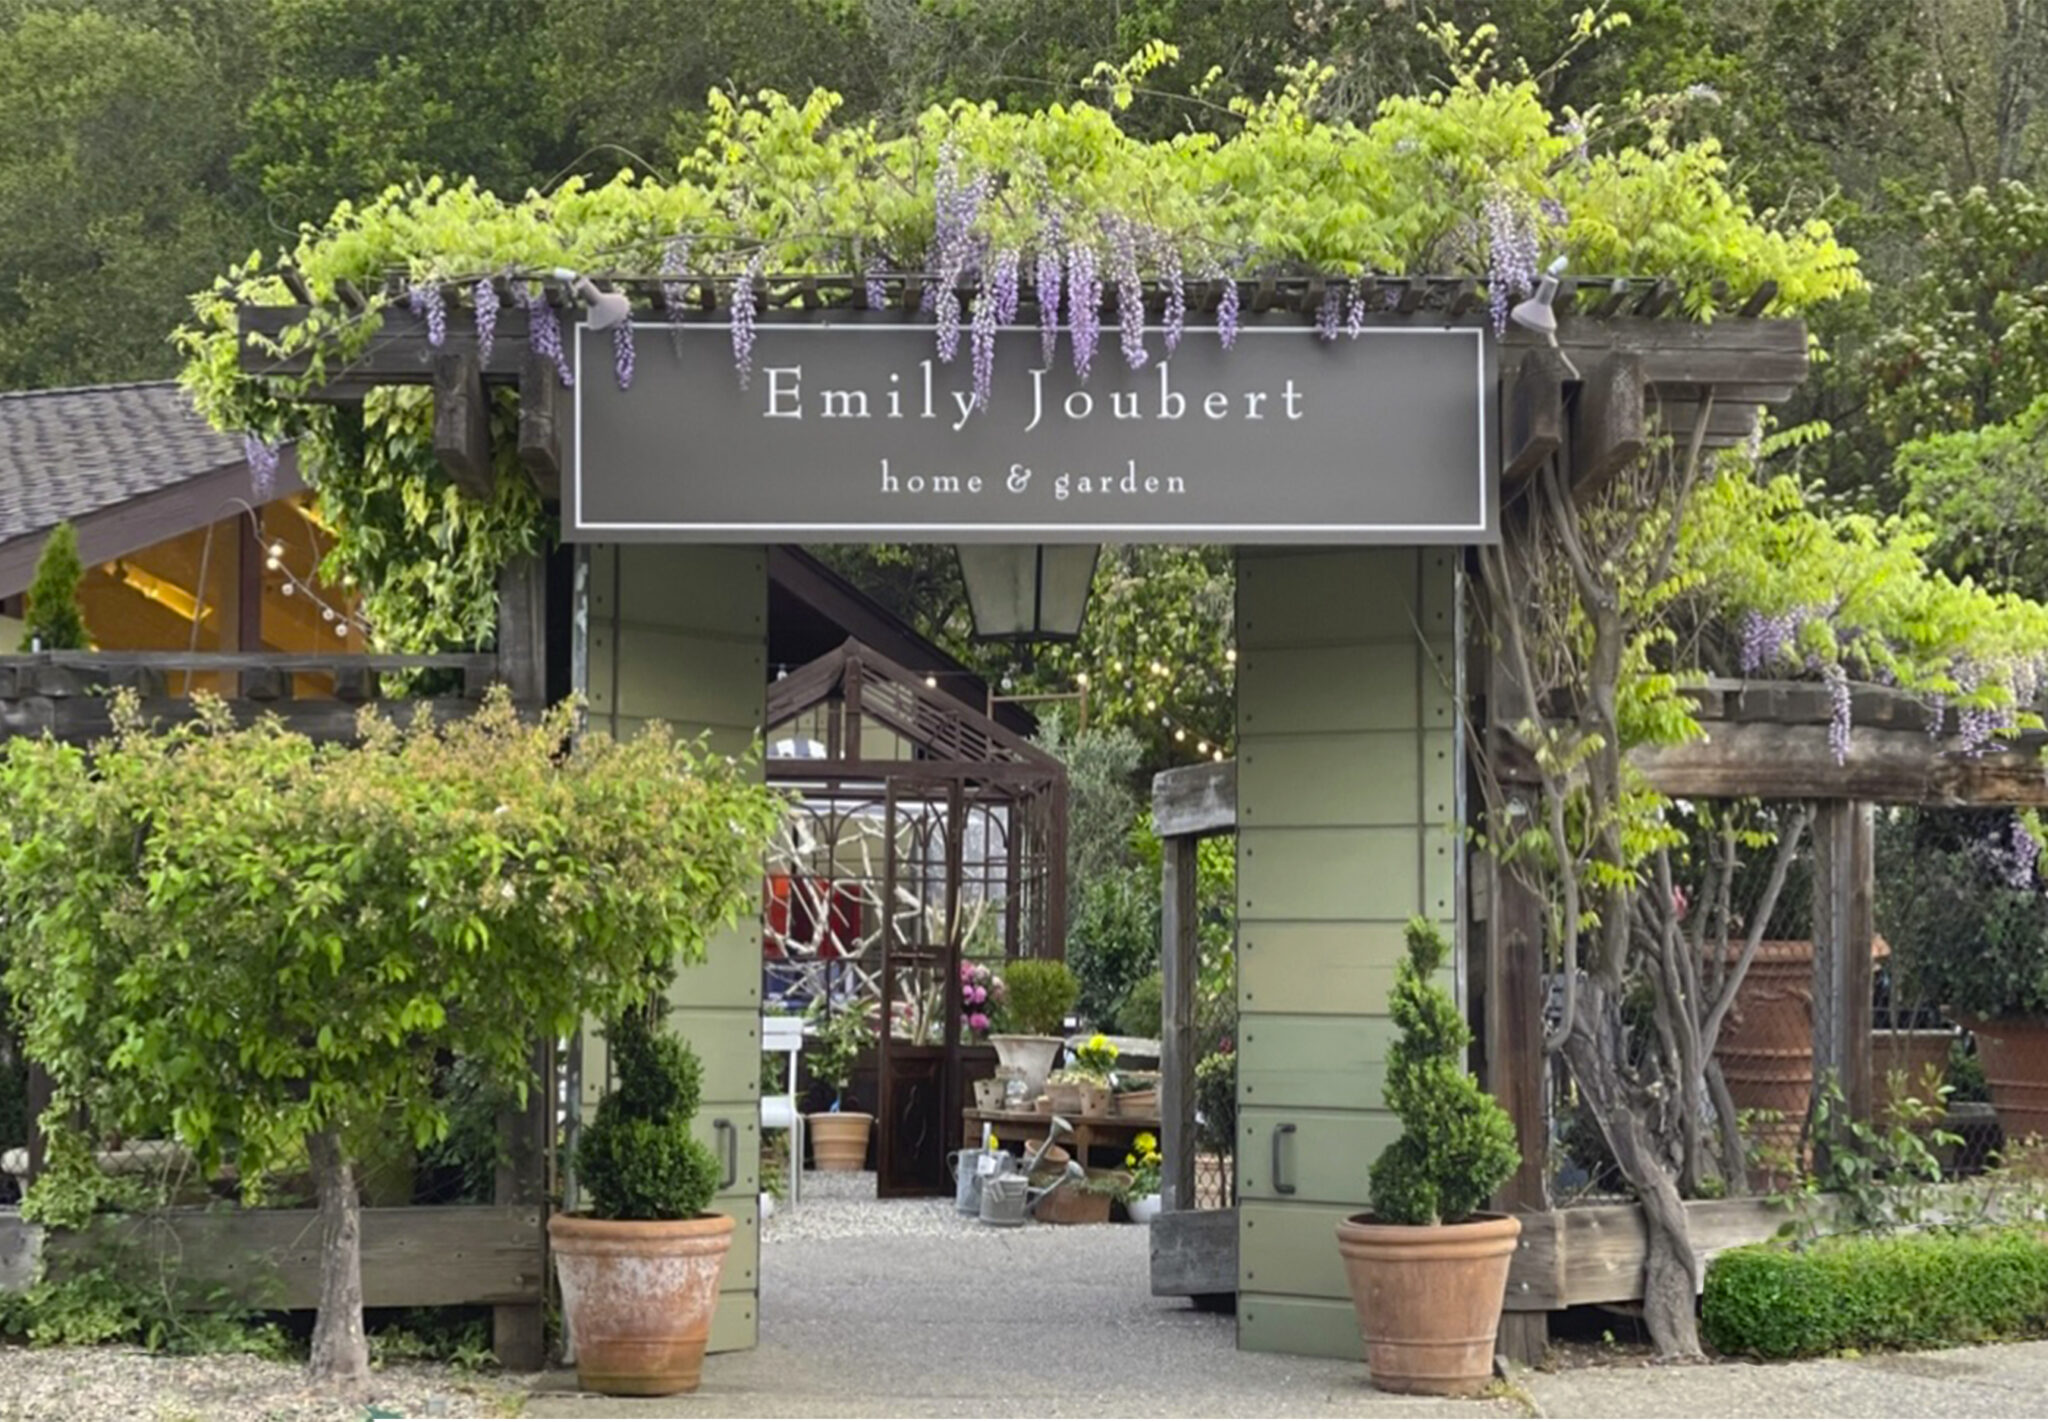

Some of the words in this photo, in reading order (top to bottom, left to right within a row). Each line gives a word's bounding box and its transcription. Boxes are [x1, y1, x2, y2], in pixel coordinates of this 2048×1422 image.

[762, 359, 980, 431] Emily
[1024, 359, 1304, 432] Joubert
[880, 458, 983, 494] home
[1005, 462, 1033, 494] &
[1053, 458, 1187, 501] garden
